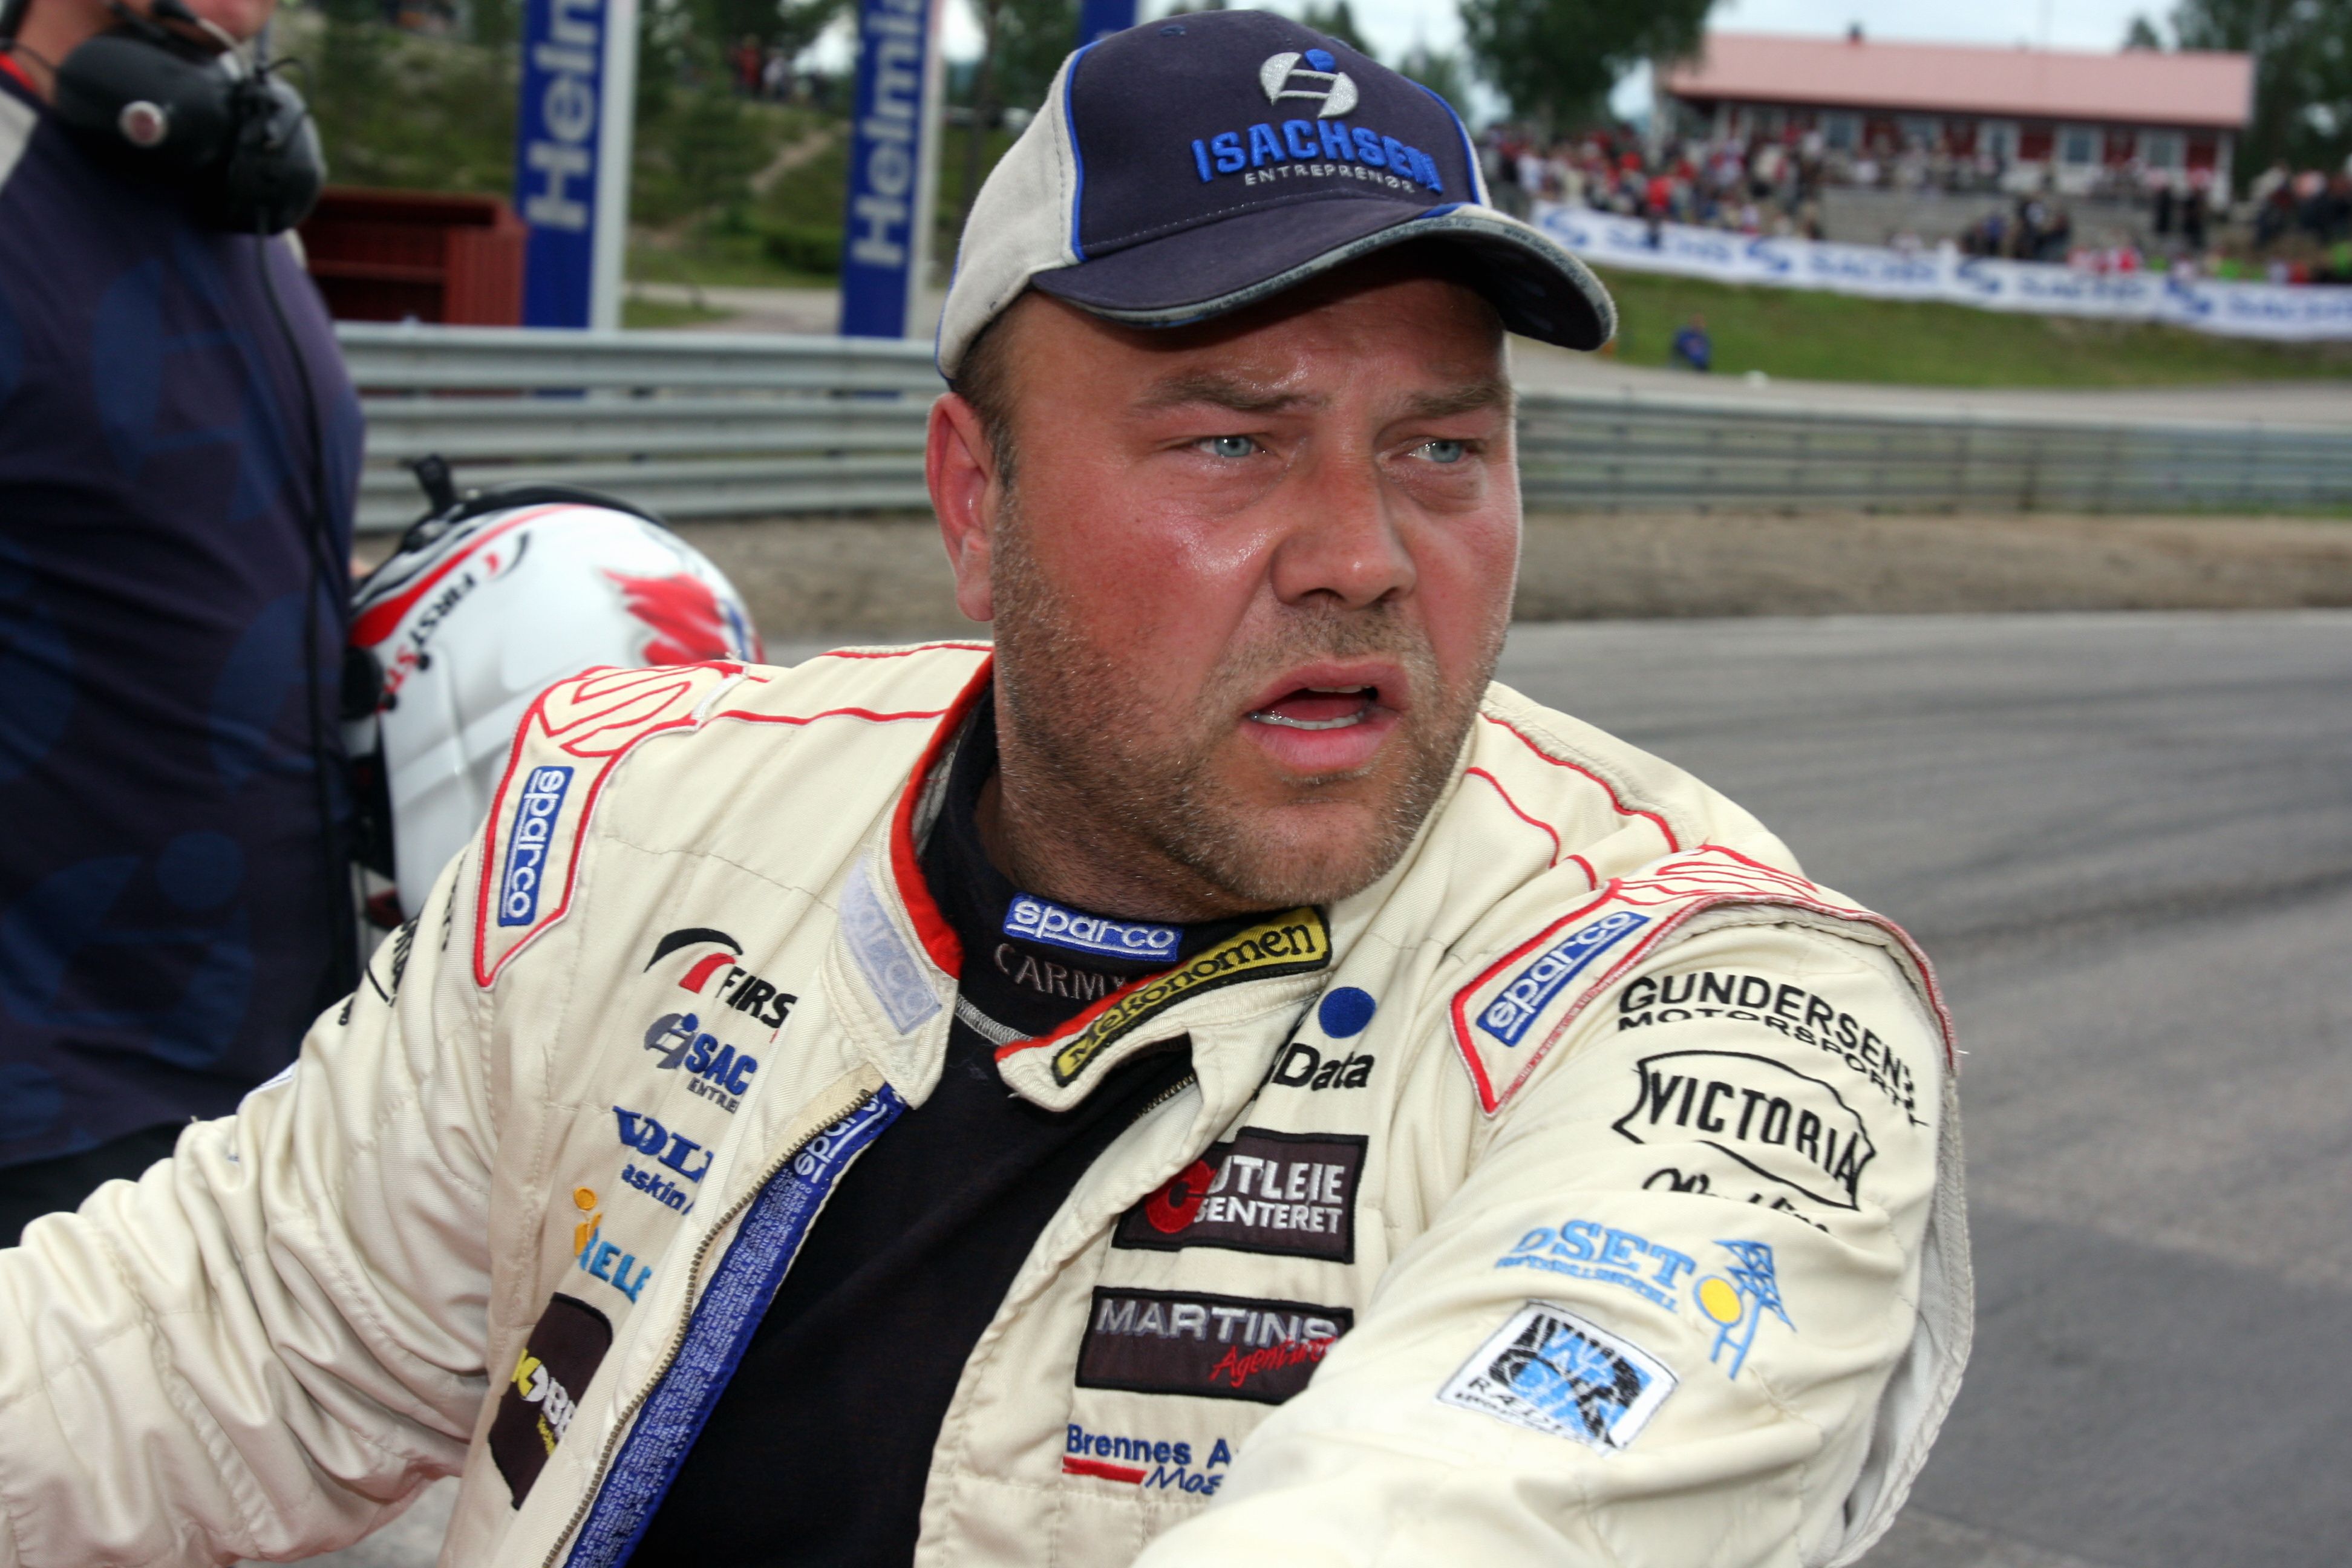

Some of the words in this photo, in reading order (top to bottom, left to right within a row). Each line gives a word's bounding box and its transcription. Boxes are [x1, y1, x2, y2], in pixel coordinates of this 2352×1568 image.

[1191, 119, 1445, 195] ISACHSEN
[509, 769, 565, 919] sparco
[1014, 900, 1175, 949] sparco
[1067, 923, 1317, 1066] Mekonomen
[1486, 912, 1632, 1028] sparco
[1272, 1042, 1375, 1091] Data
[1650, 1070, 1860, 1196] VICTORIA
[1096, 1298, 1339, 1351] MARTINS
[1066, 1423, 1192, 1466] Brennes
